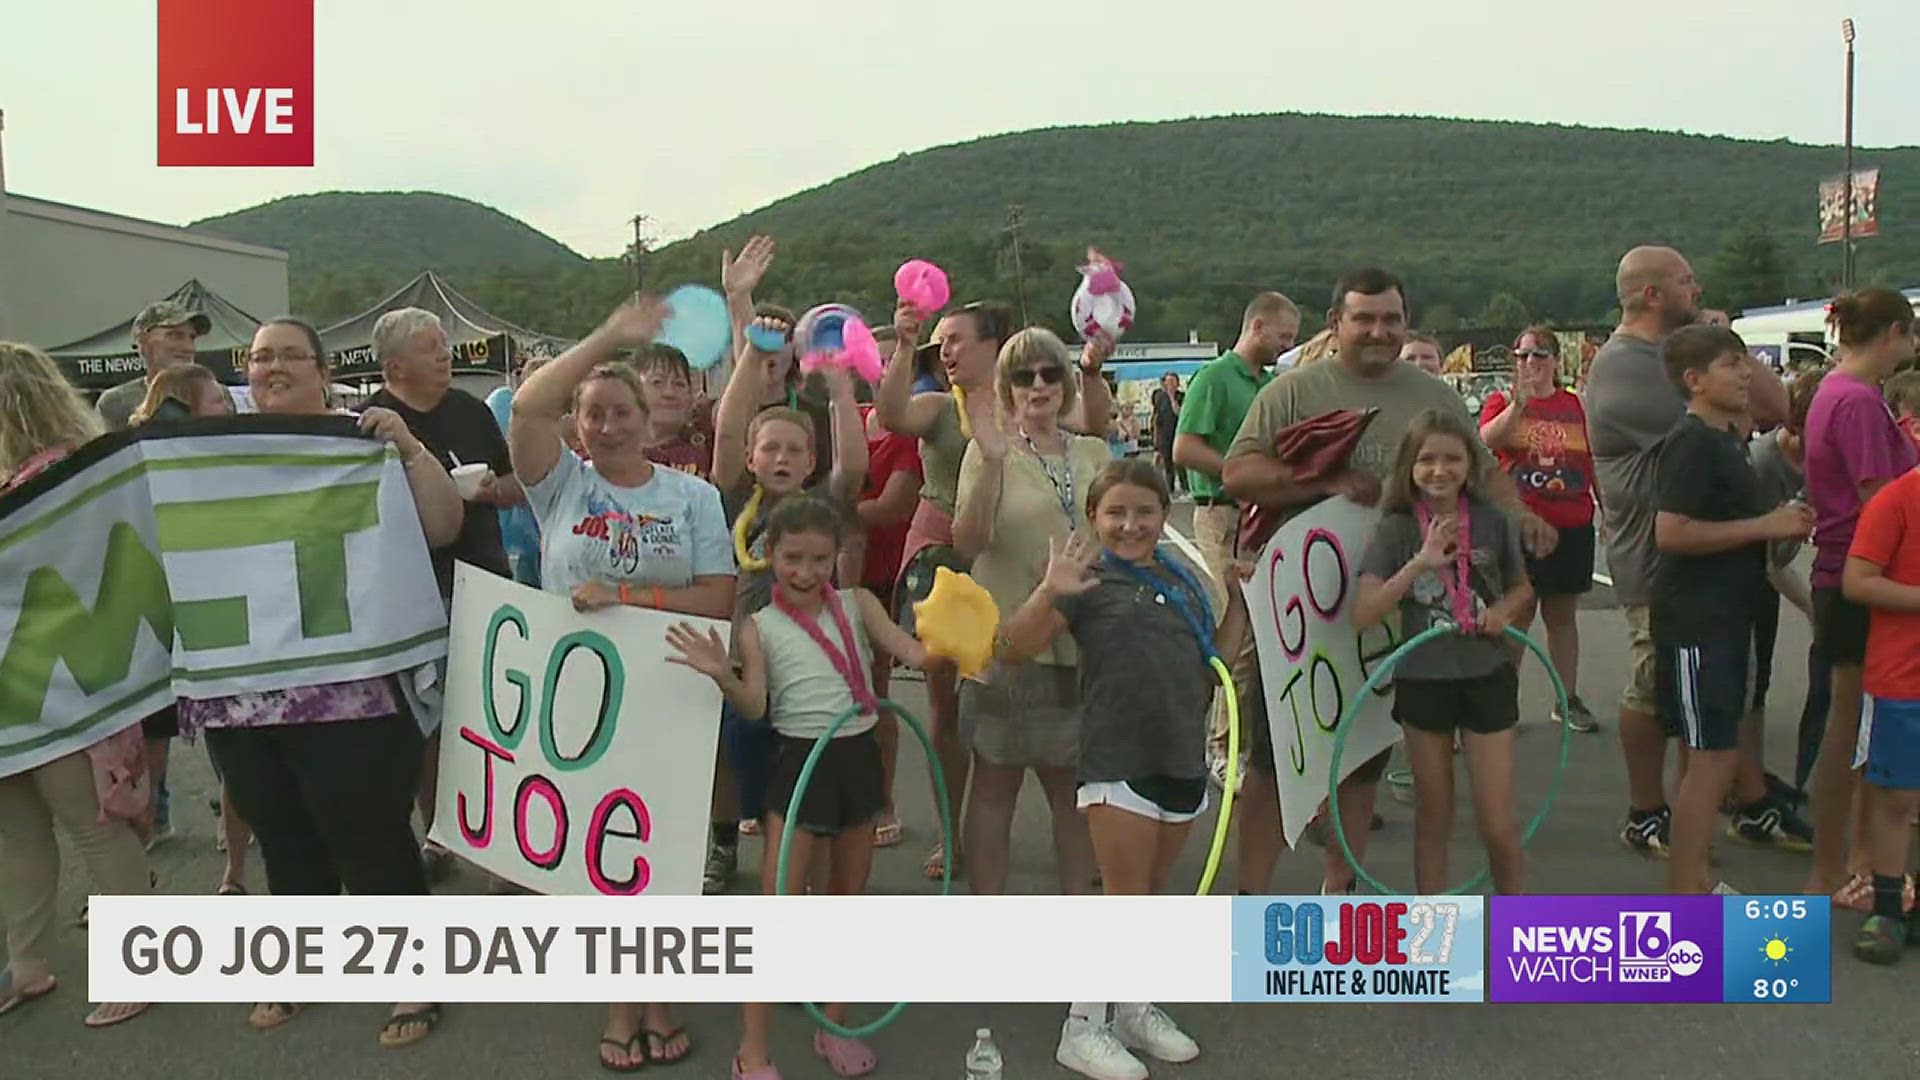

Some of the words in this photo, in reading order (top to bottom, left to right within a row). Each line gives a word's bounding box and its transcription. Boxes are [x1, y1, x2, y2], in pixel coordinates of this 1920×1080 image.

[78, 359, 103, 374] THE
[105, 357, 142, 372] NEWS
[340, 349, 378, 366] NEW
[1270, 527, 1349, 662] GO
[482, 604, 626, 772] GO
